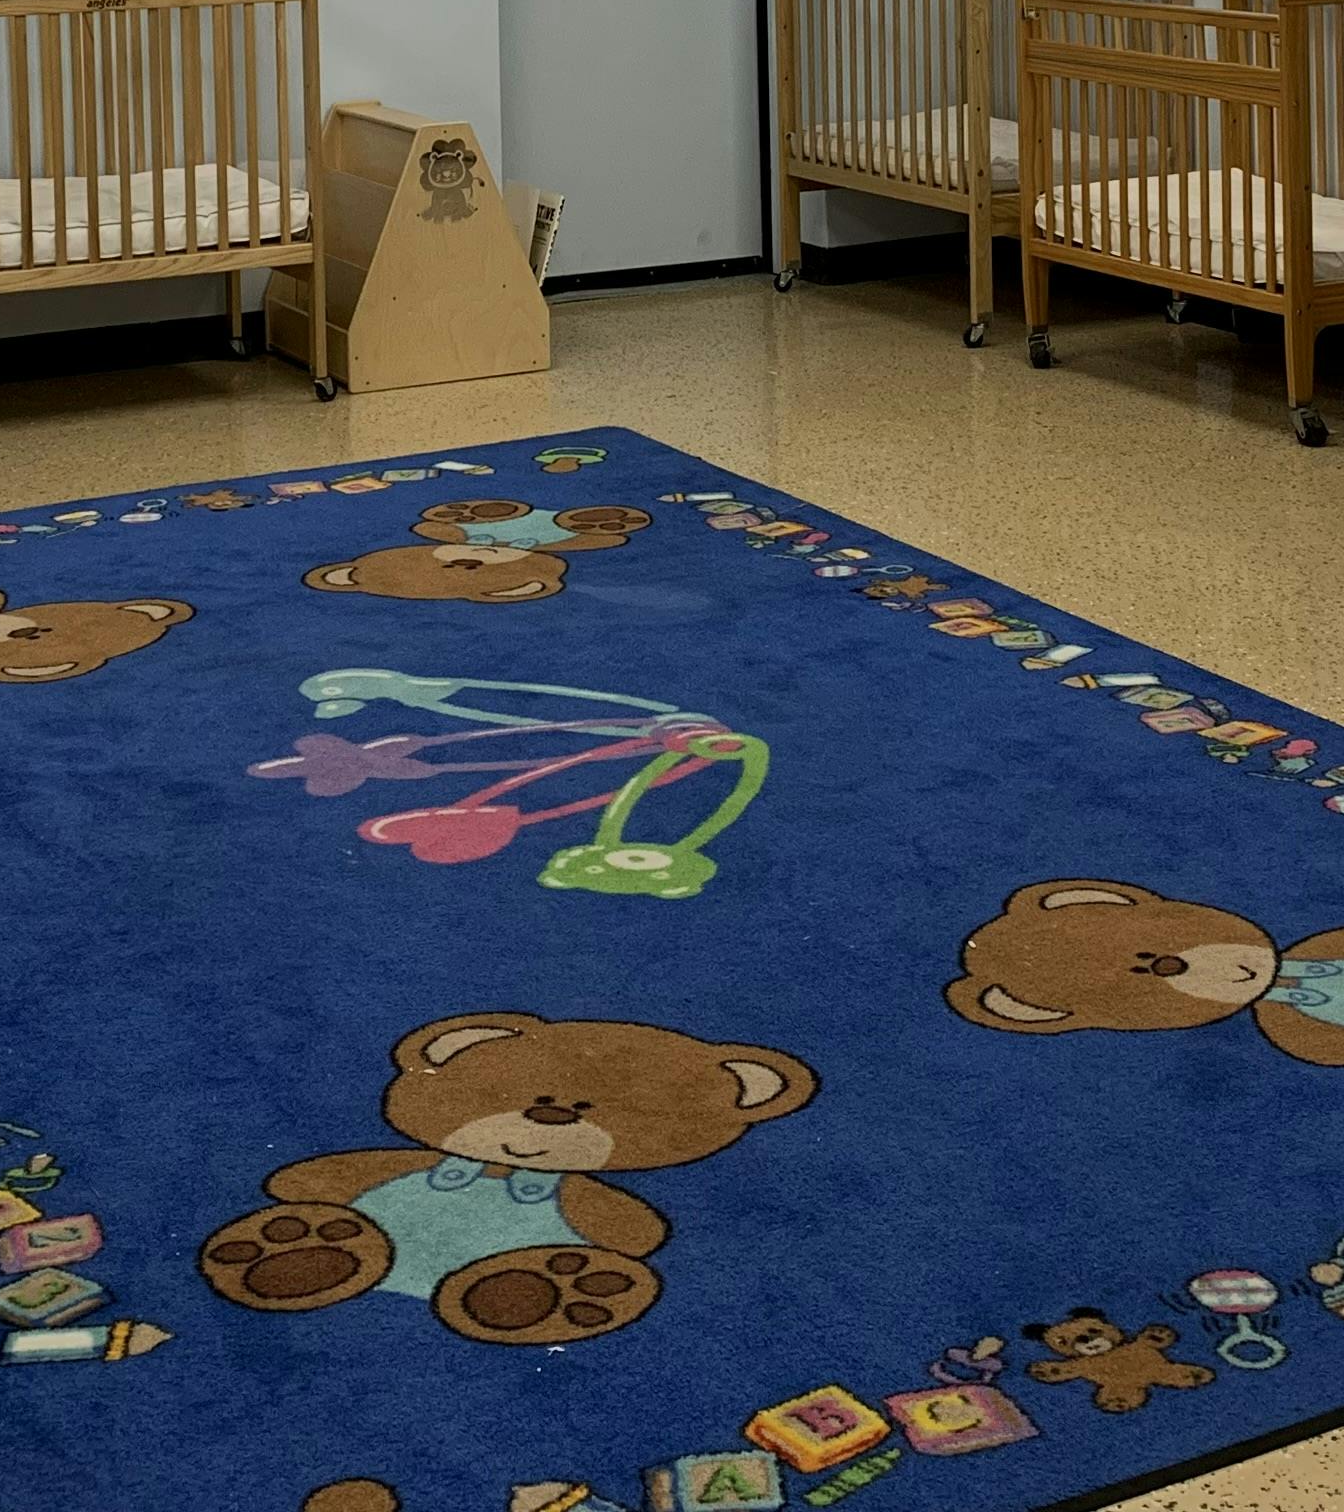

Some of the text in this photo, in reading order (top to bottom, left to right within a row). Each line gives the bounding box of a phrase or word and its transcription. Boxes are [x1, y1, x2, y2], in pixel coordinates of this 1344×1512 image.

[697, 1392, 986, 1504] A B C
